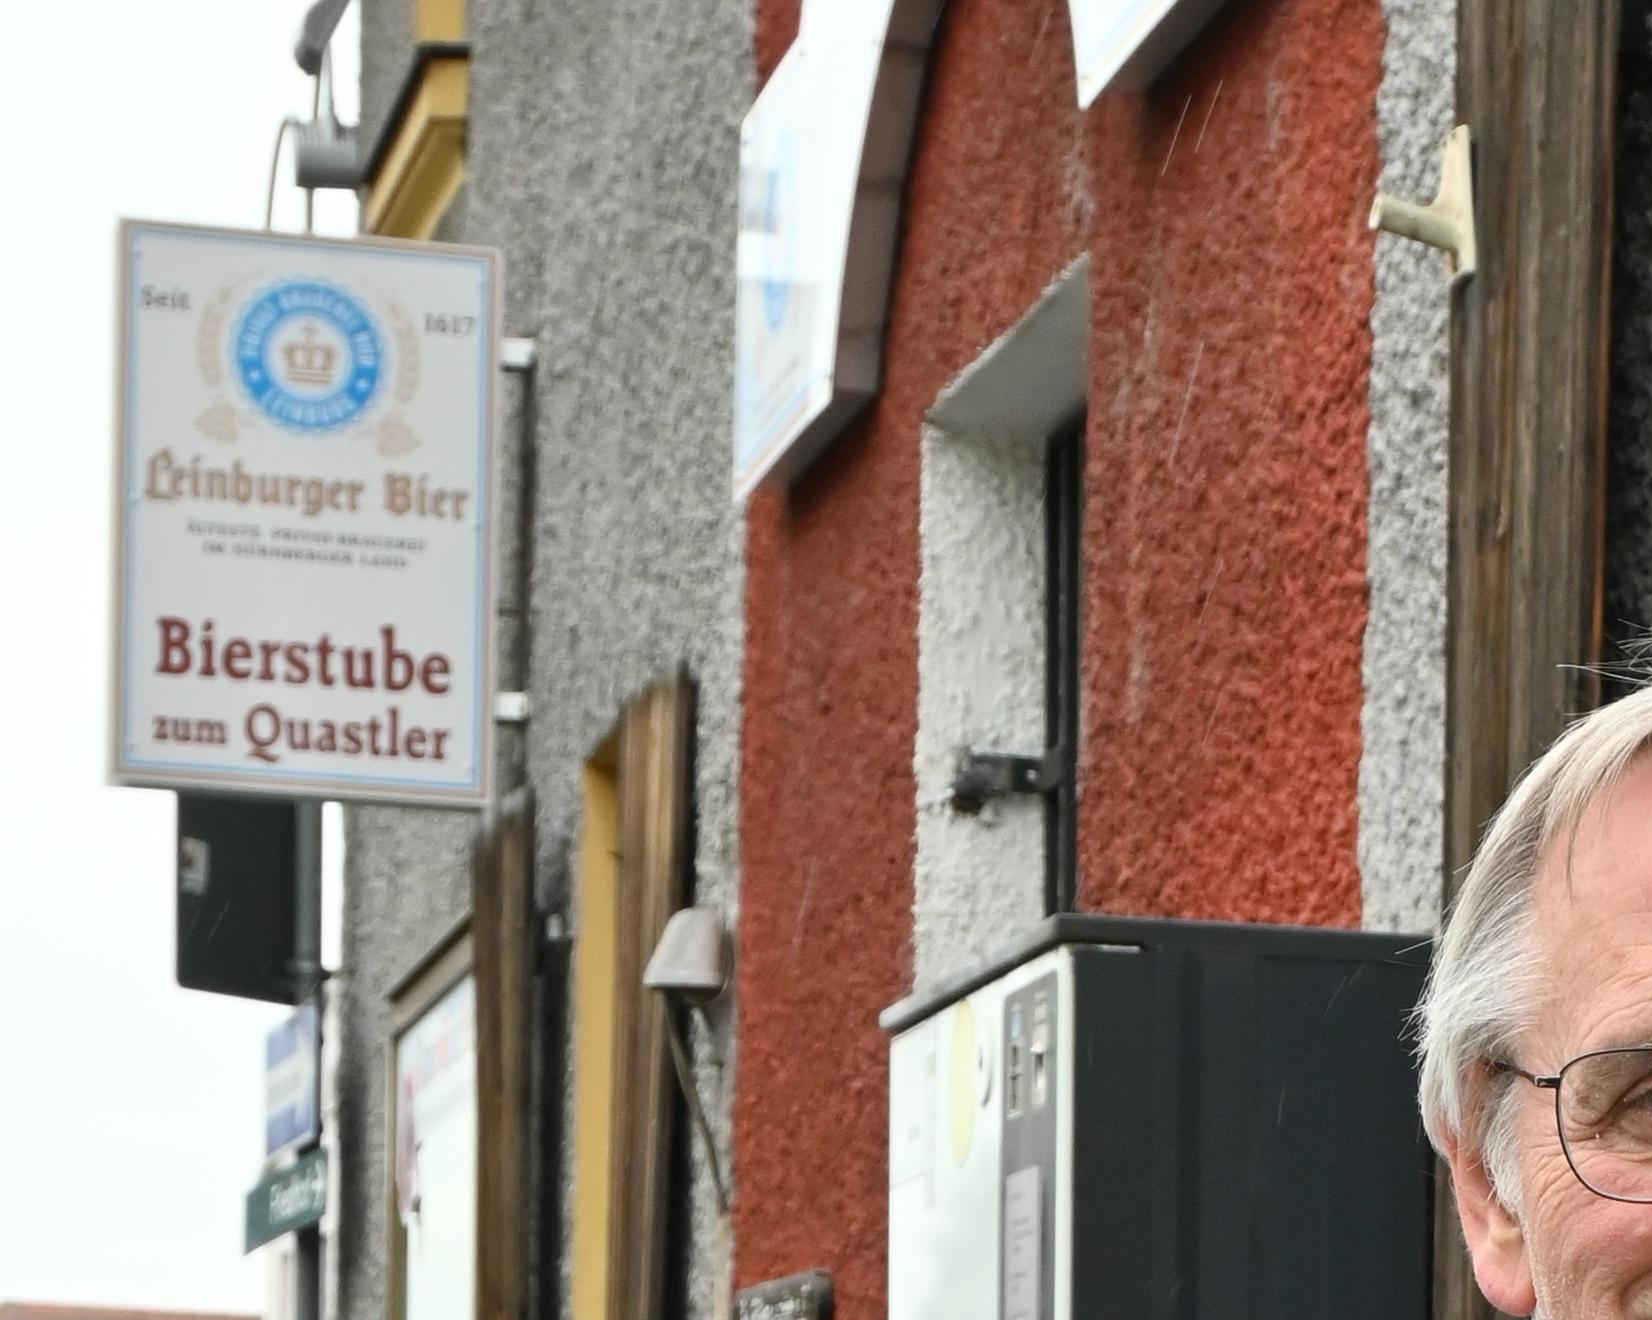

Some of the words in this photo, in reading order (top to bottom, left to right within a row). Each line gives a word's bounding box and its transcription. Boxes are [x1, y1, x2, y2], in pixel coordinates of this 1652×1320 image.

[140, 284, 191, 310] Seit
[424, 312, 477, 336] 1617
[144, 446, 366, 517] Leinburger
[382, 470, 470, 521] Bier
[155, 615, 452, 694] Bierstube
[153, 714, 227, 745] zum
[244, 702, 450, 762] Quastler
